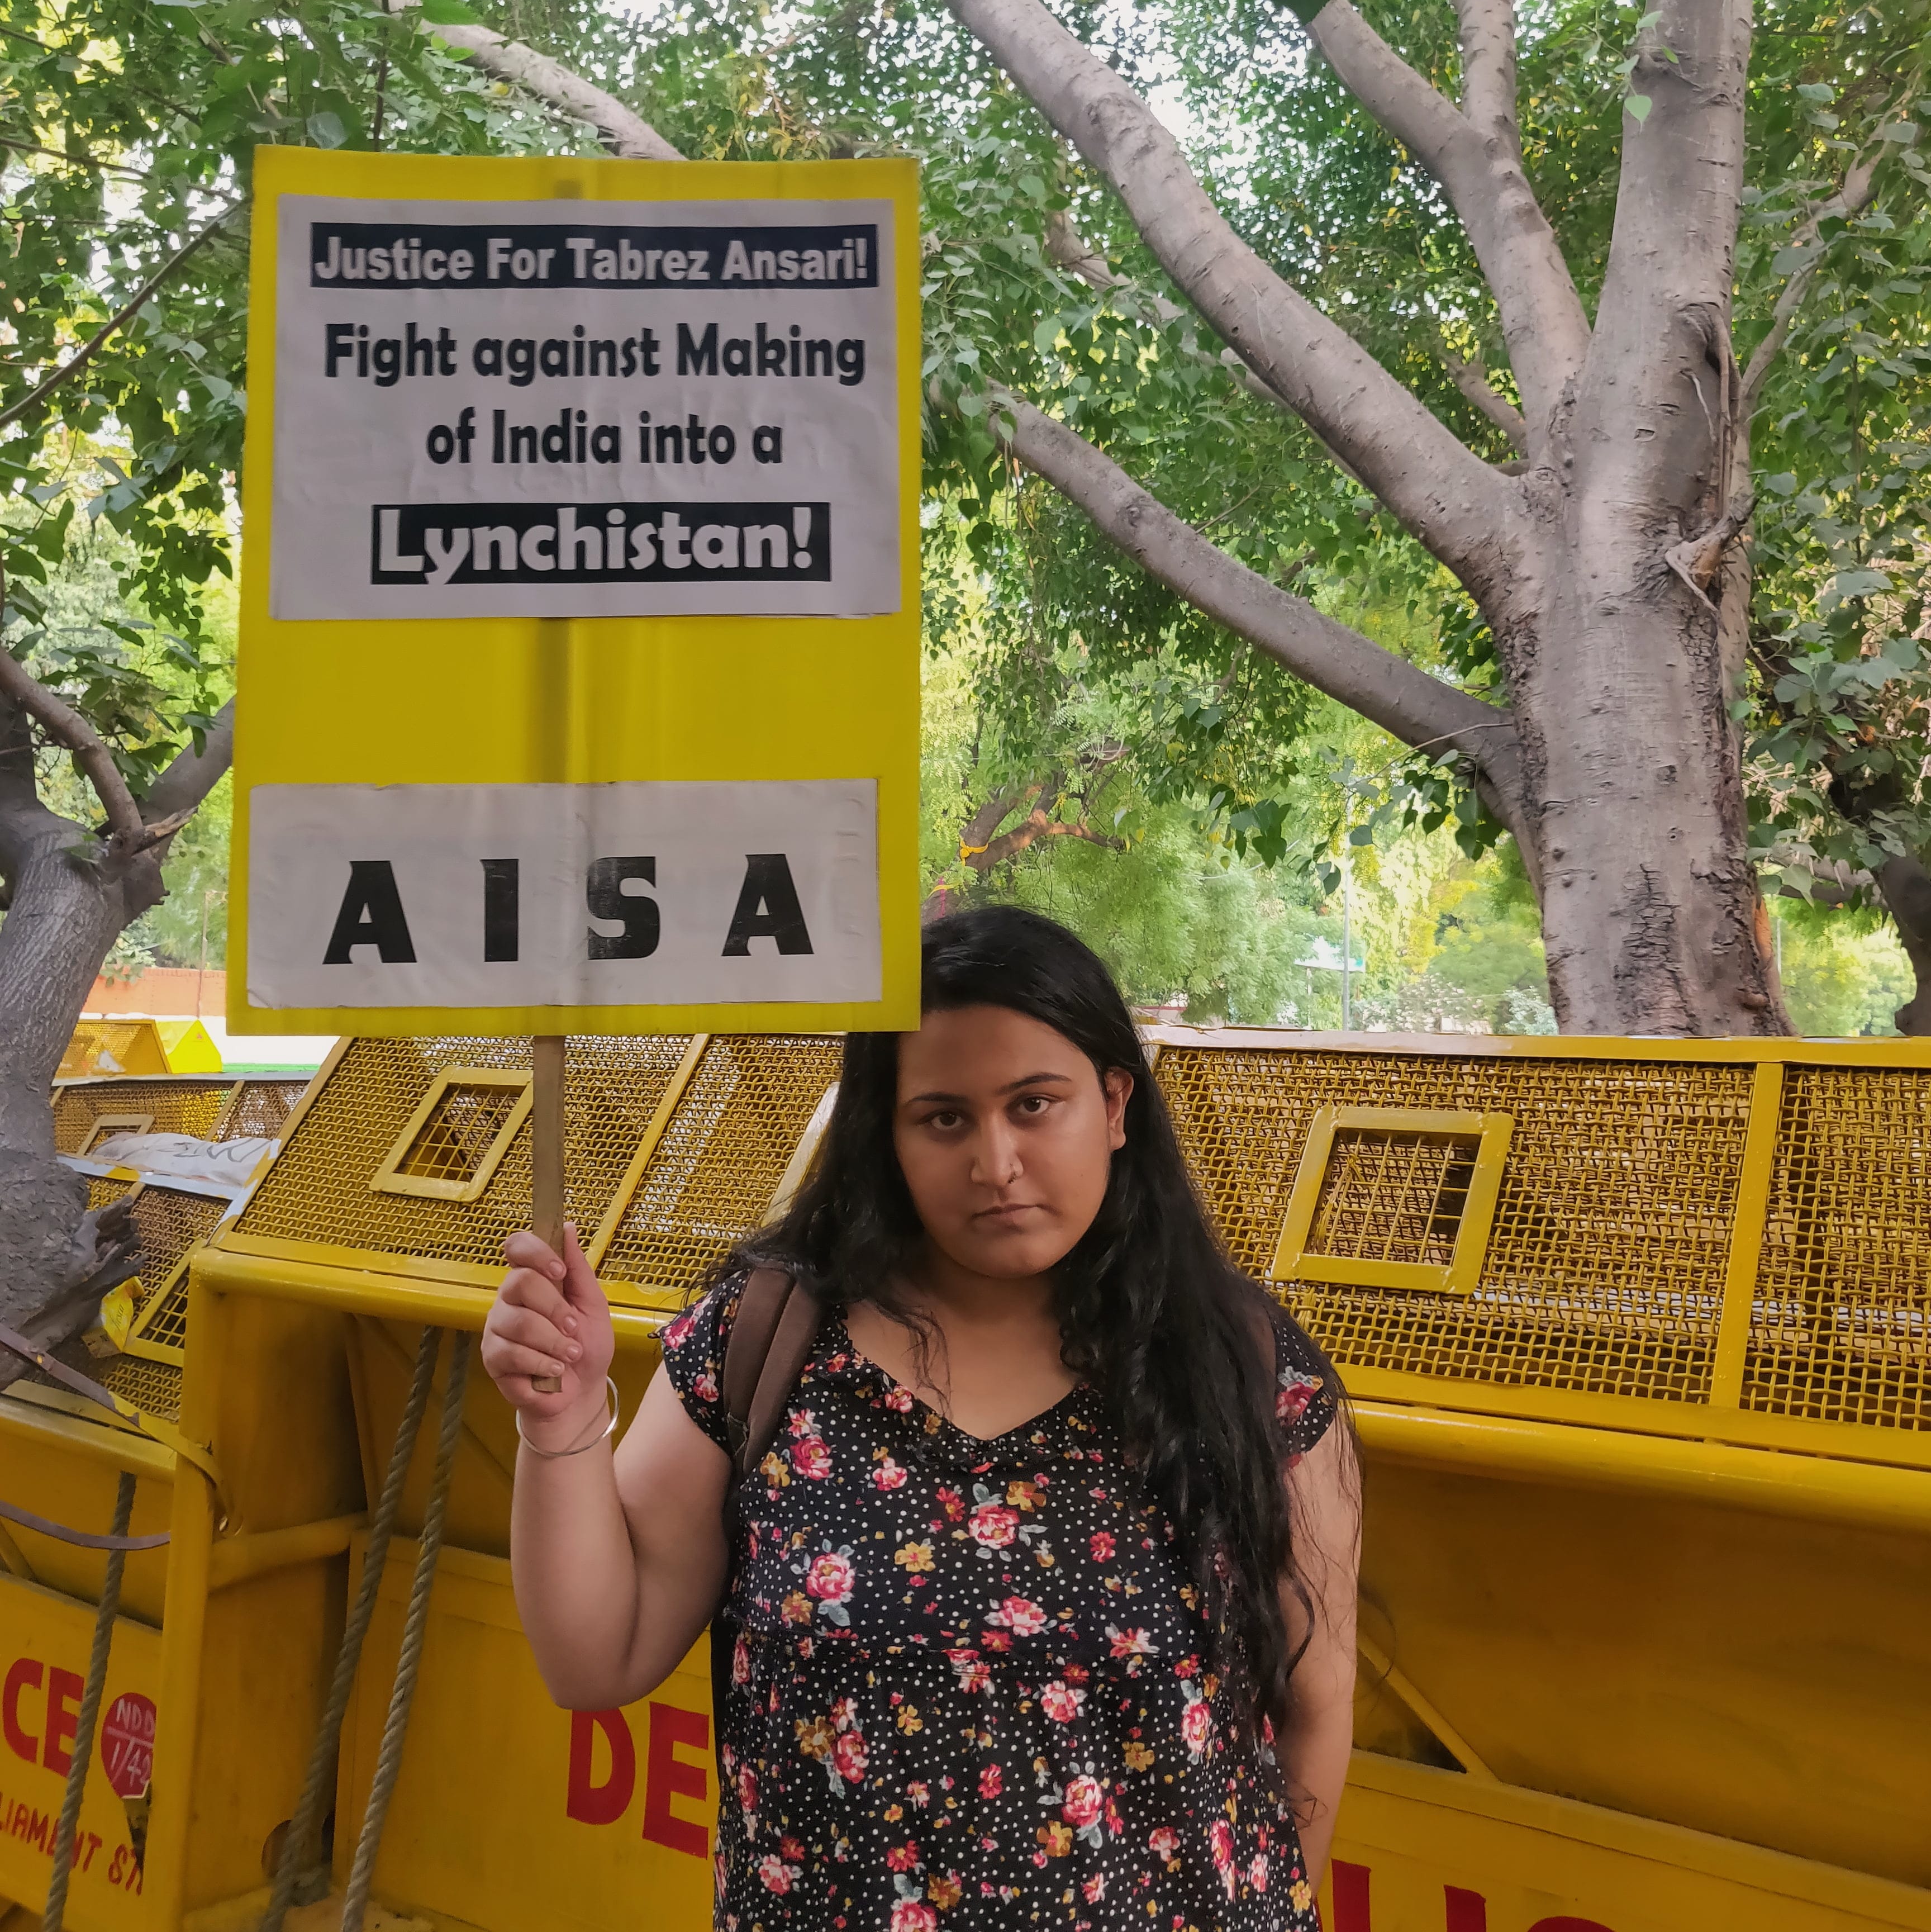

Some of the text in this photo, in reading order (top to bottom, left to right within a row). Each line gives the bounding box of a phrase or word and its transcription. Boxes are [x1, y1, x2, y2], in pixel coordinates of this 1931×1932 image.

[315, 237, 868, 281] Justice For Tabrez Ansari!
[325, 321, 866, 387] Fight against Making
[426, 406, 783, 465] of India into a
[378, 506, 813, 584] Lynchistan!
